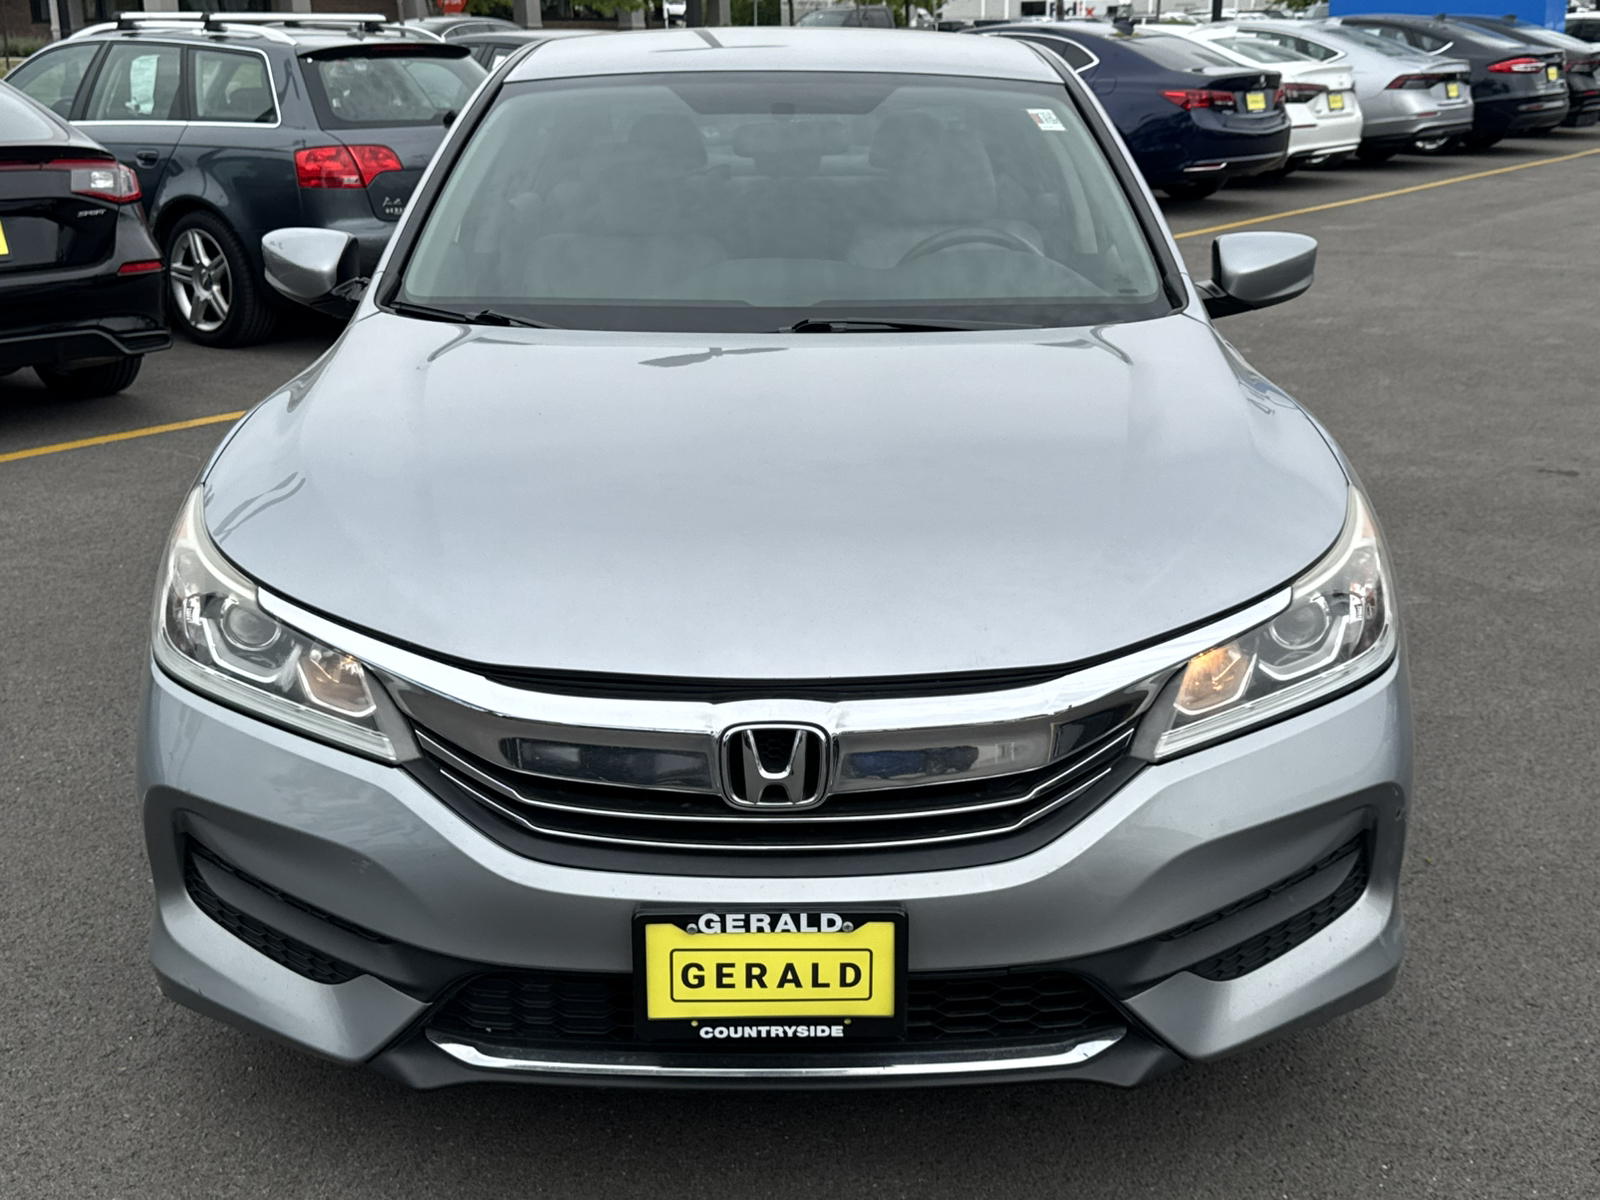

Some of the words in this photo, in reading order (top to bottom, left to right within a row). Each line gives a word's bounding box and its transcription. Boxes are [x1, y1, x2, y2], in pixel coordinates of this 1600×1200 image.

[697, 912, 844, 935] GERALD
[680, 962, 863, 989] GERALD
[699, 1025, 844, 1039] COUNTRYSIDE
